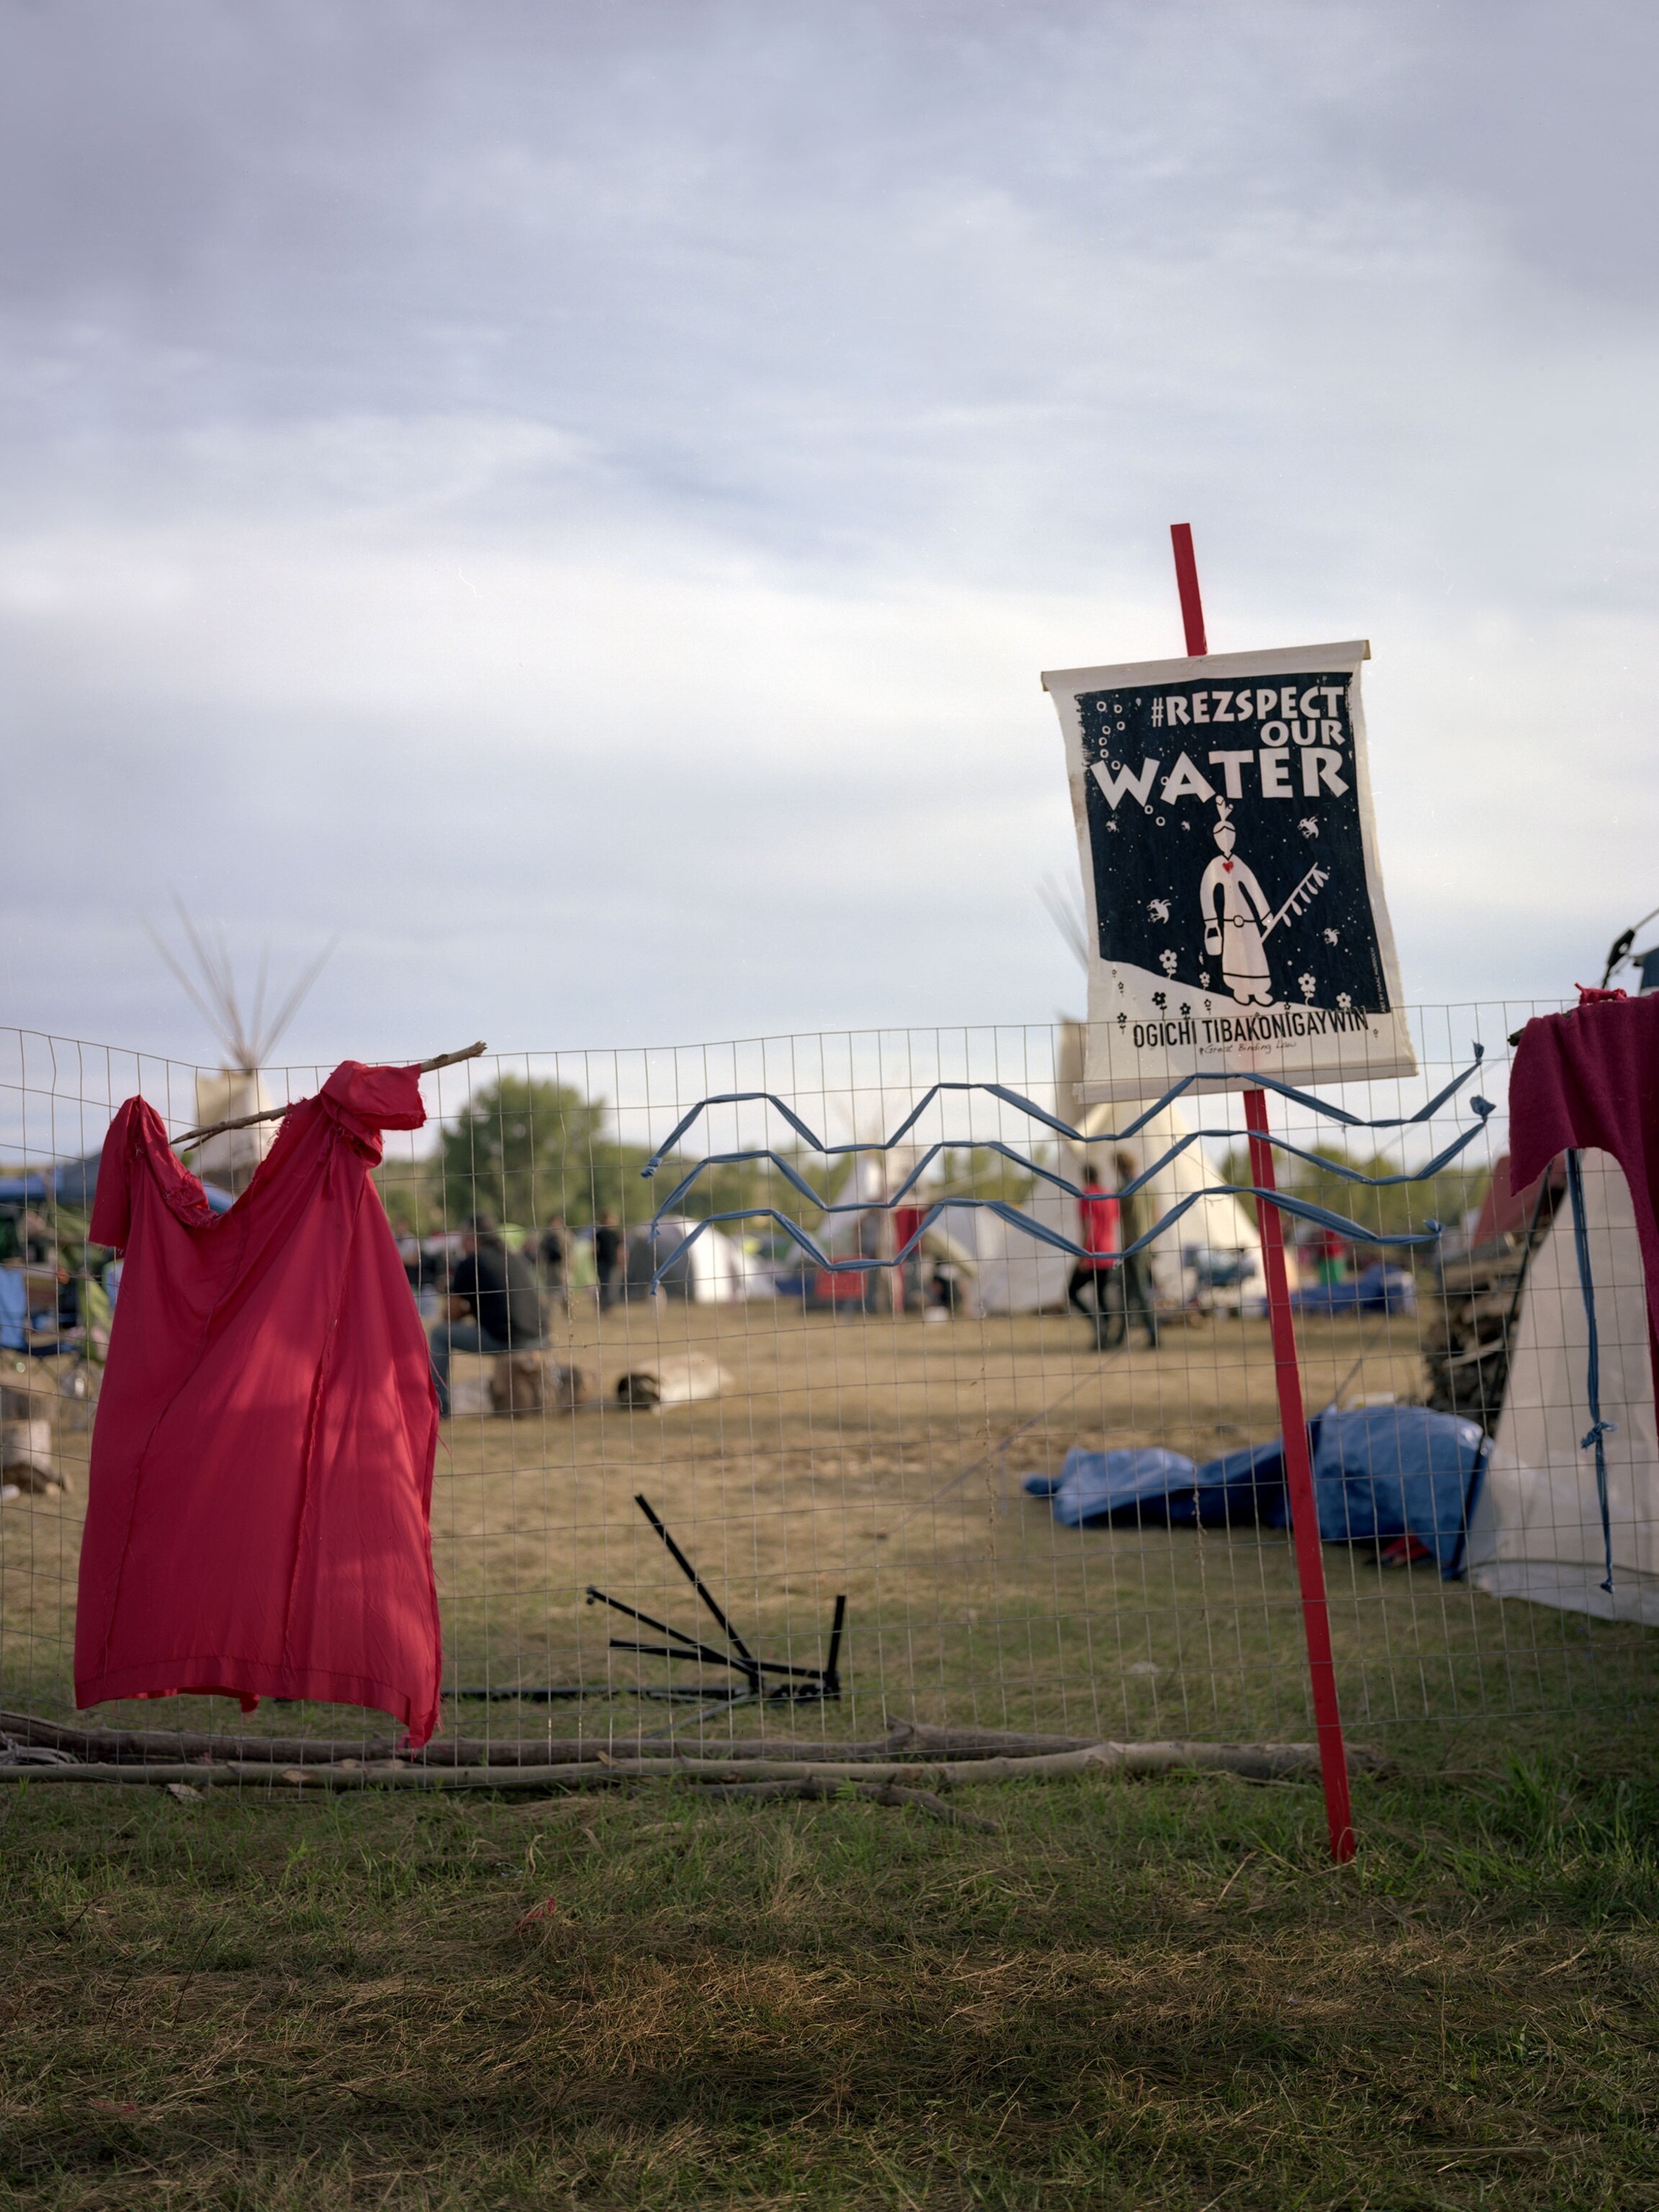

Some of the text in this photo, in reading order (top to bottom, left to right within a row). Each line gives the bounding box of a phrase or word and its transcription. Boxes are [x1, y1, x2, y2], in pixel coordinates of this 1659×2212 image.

[1151, 686, 1344, 727] #REZSPECT
[1261, 720, 1346, 747] OUR
[1089, 747, 1349, 811] WATER
[1133, 1005, 1369, 1047] OGICHI TIBAKONIGAYWIN
[1205, 1044, 1233, 1053] Great
[1238, 1043, 1271, 1054] Binding
